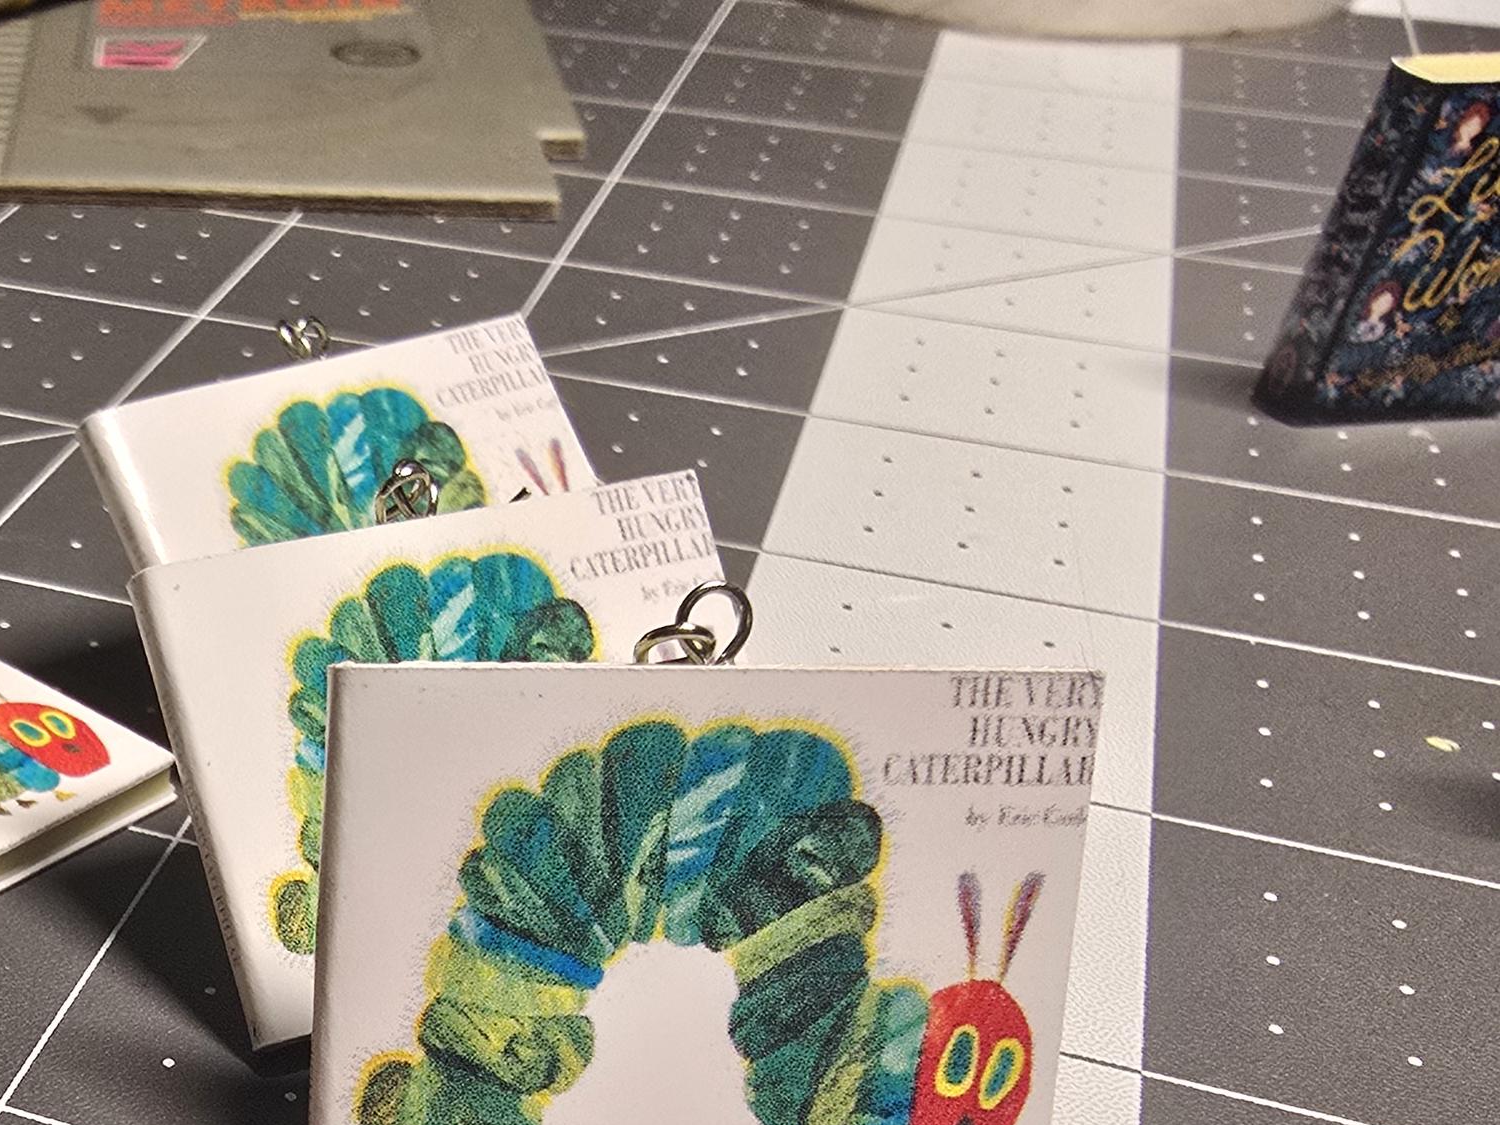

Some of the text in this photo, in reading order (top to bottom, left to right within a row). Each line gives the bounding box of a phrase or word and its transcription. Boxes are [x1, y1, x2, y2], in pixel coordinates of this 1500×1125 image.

[446, 328, 482, 354] THE
[591, 487, 640, 515] THE
[617, 503, 708, 541] HUNGRY
[951, 673, 1104, 708] THE VERY
[969, 714, 1097, 747] HUNGRY
